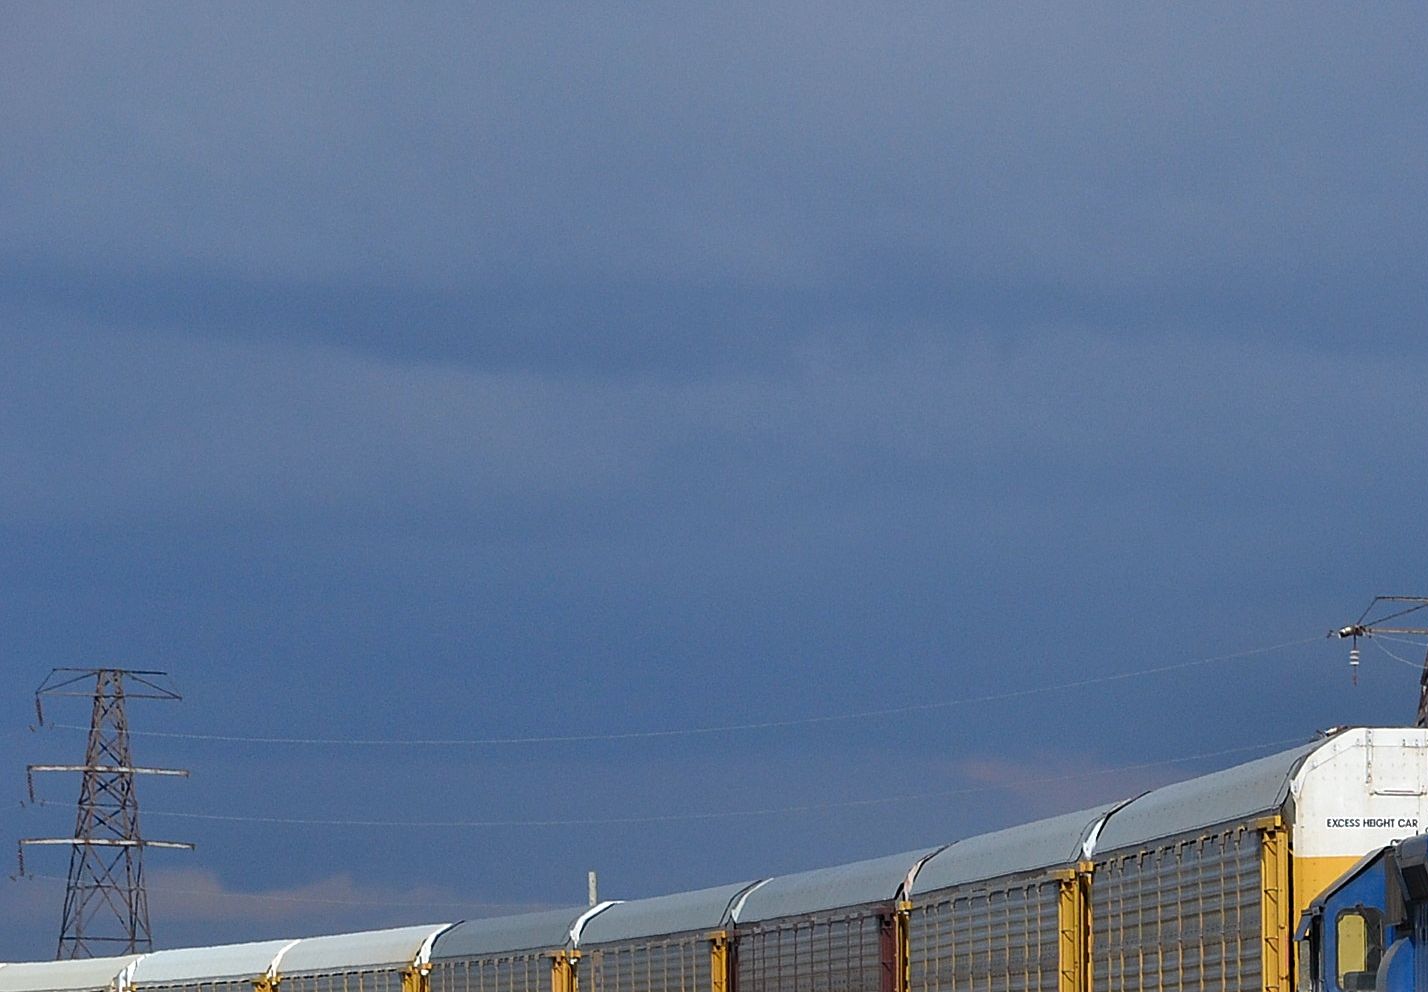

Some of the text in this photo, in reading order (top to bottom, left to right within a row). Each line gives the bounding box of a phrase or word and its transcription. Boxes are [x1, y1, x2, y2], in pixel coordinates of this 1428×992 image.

[1326, 818, 1419, 828] EXCESS HEIGHT CAR
